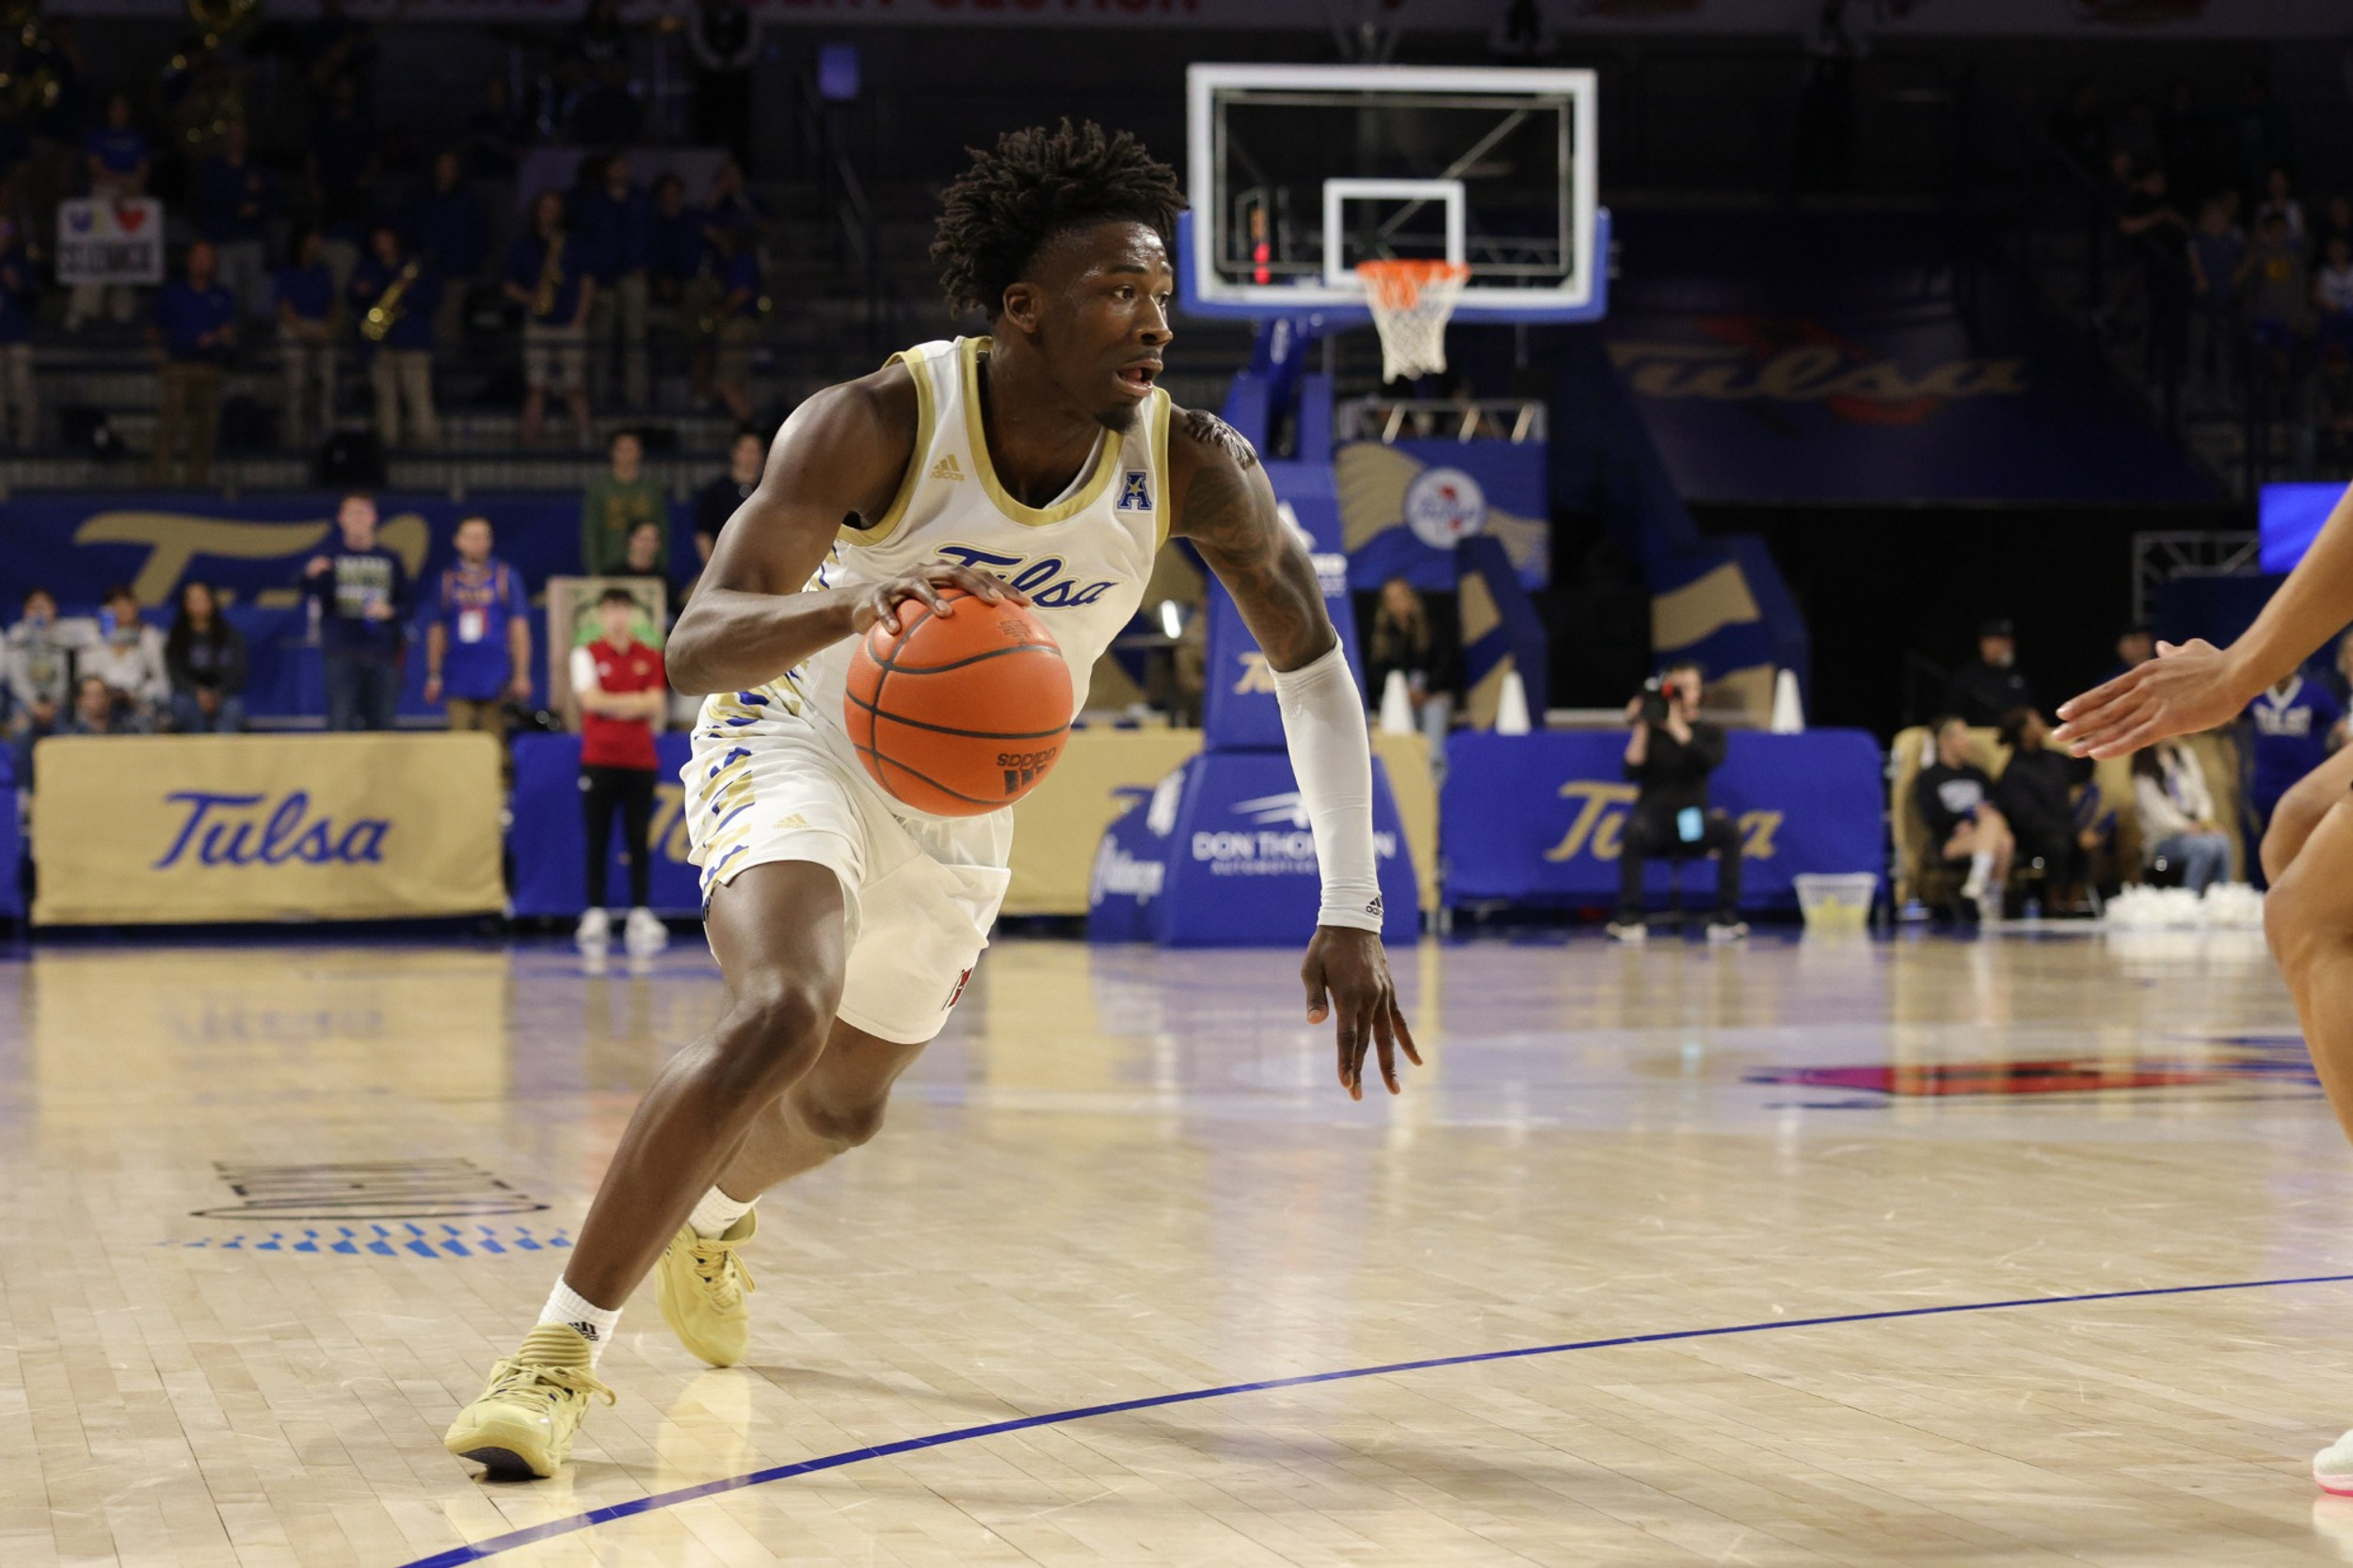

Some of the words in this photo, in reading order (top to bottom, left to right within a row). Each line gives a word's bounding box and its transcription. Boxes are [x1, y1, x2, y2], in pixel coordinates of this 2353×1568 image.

[936, 543, 1120, 609] Tlsa
[152, 789, 391, 871] Tulsa
[1192, 830, 1256, 862] DON
[1543, 777, 1785, 864] Tua
